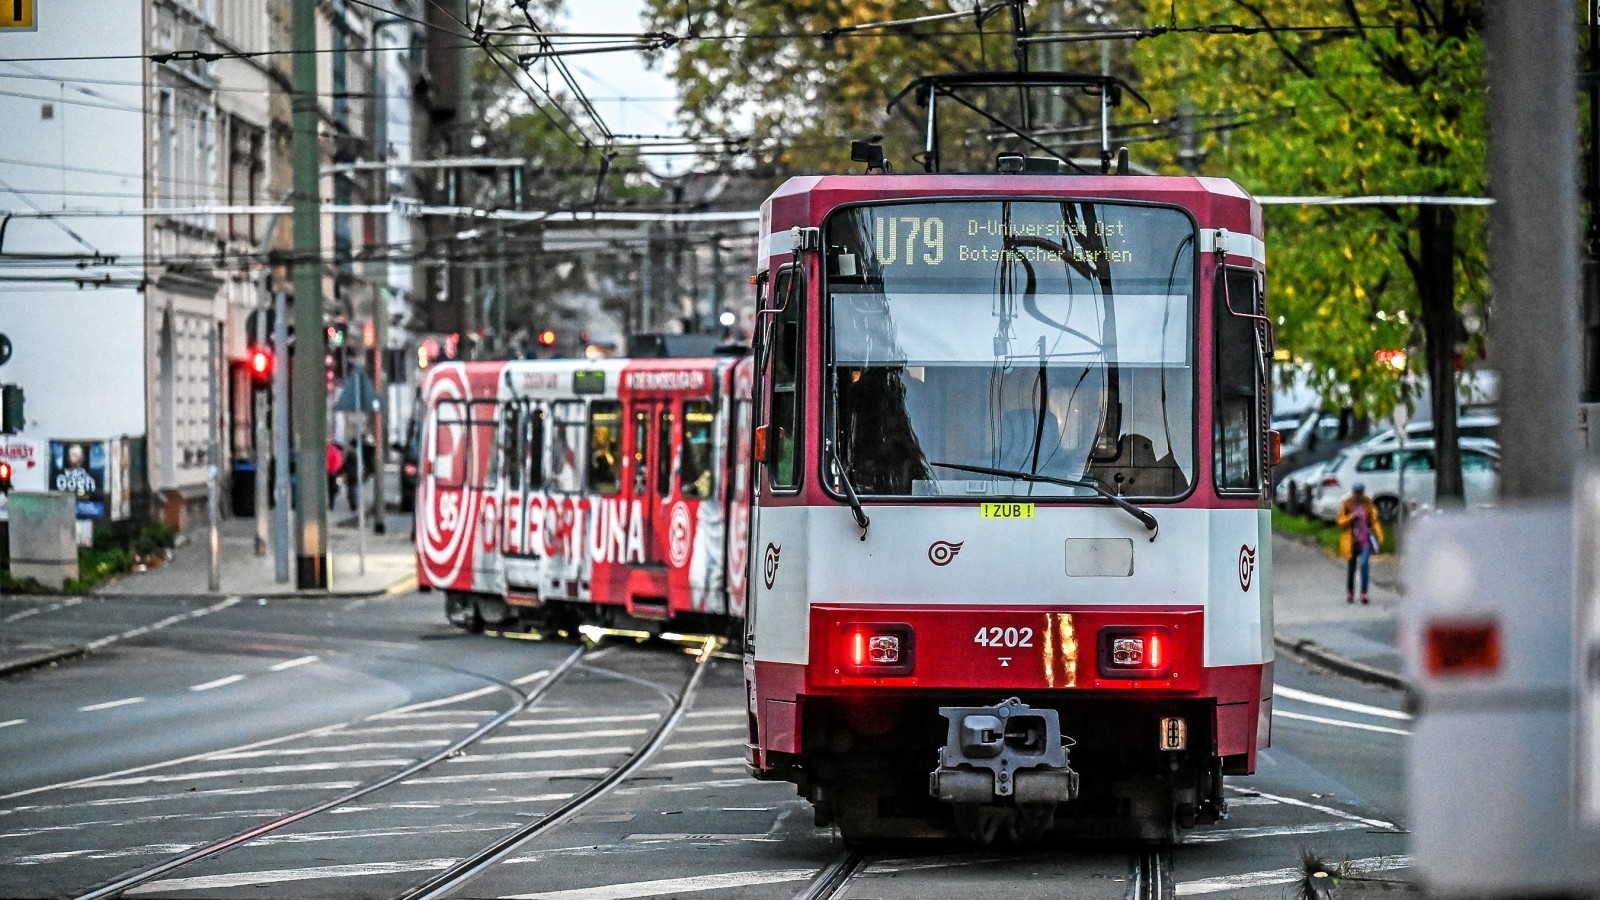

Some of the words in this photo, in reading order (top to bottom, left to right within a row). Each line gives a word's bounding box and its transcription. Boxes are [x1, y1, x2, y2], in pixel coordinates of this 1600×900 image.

[1094, 219, 1123, 236] Ost
[876, 217, 944, 265] U79
[959, 245, 1066, 262] Botanischer
[1073, 245, 1132, 262] Garten
[440, 492, 460, 531] 95
[993, 504, 1021, 517] ZUB
[974, 626, 1034, 648] 4202
